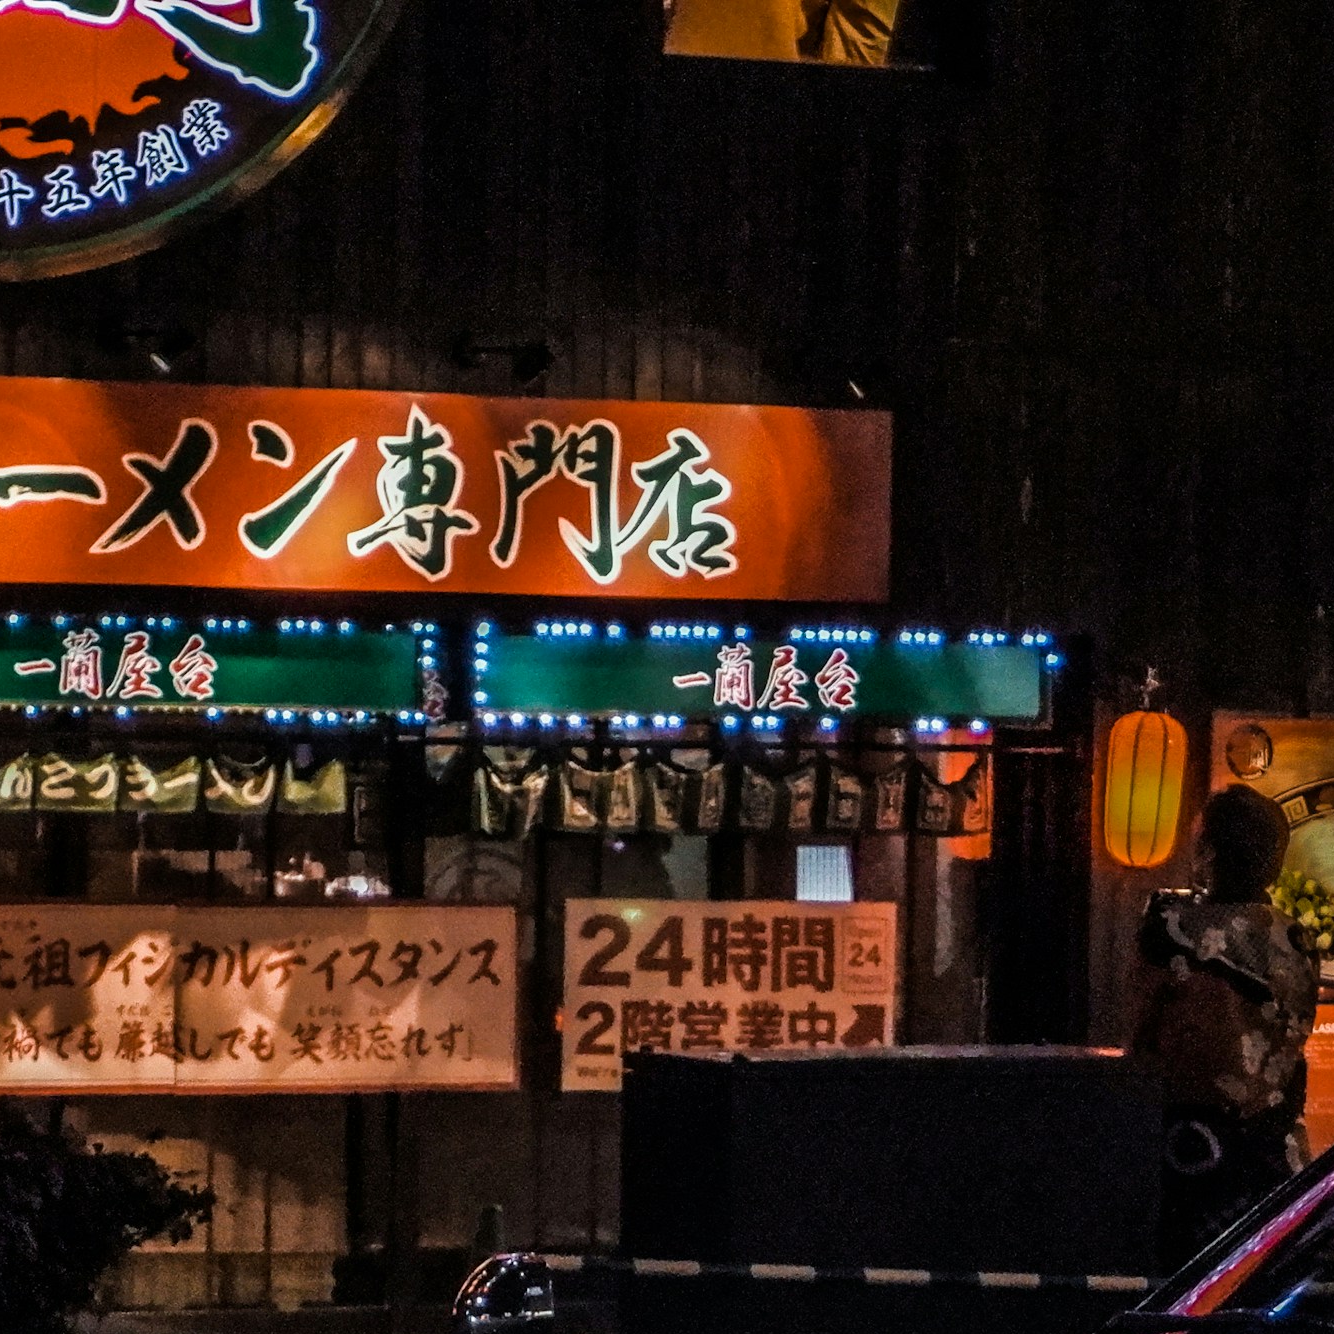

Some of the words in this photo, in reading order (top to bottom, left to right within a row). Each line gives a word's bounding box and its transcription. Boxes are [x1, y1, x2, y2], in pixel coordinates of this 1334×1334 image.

[13, 629, 219, 700] 一蘭屋台
[672, 642, 862, 711] 一蘭屋台
[578, 913, 835, 992] 24時間
[576, 1000, 837, 1055] 2階営業中
